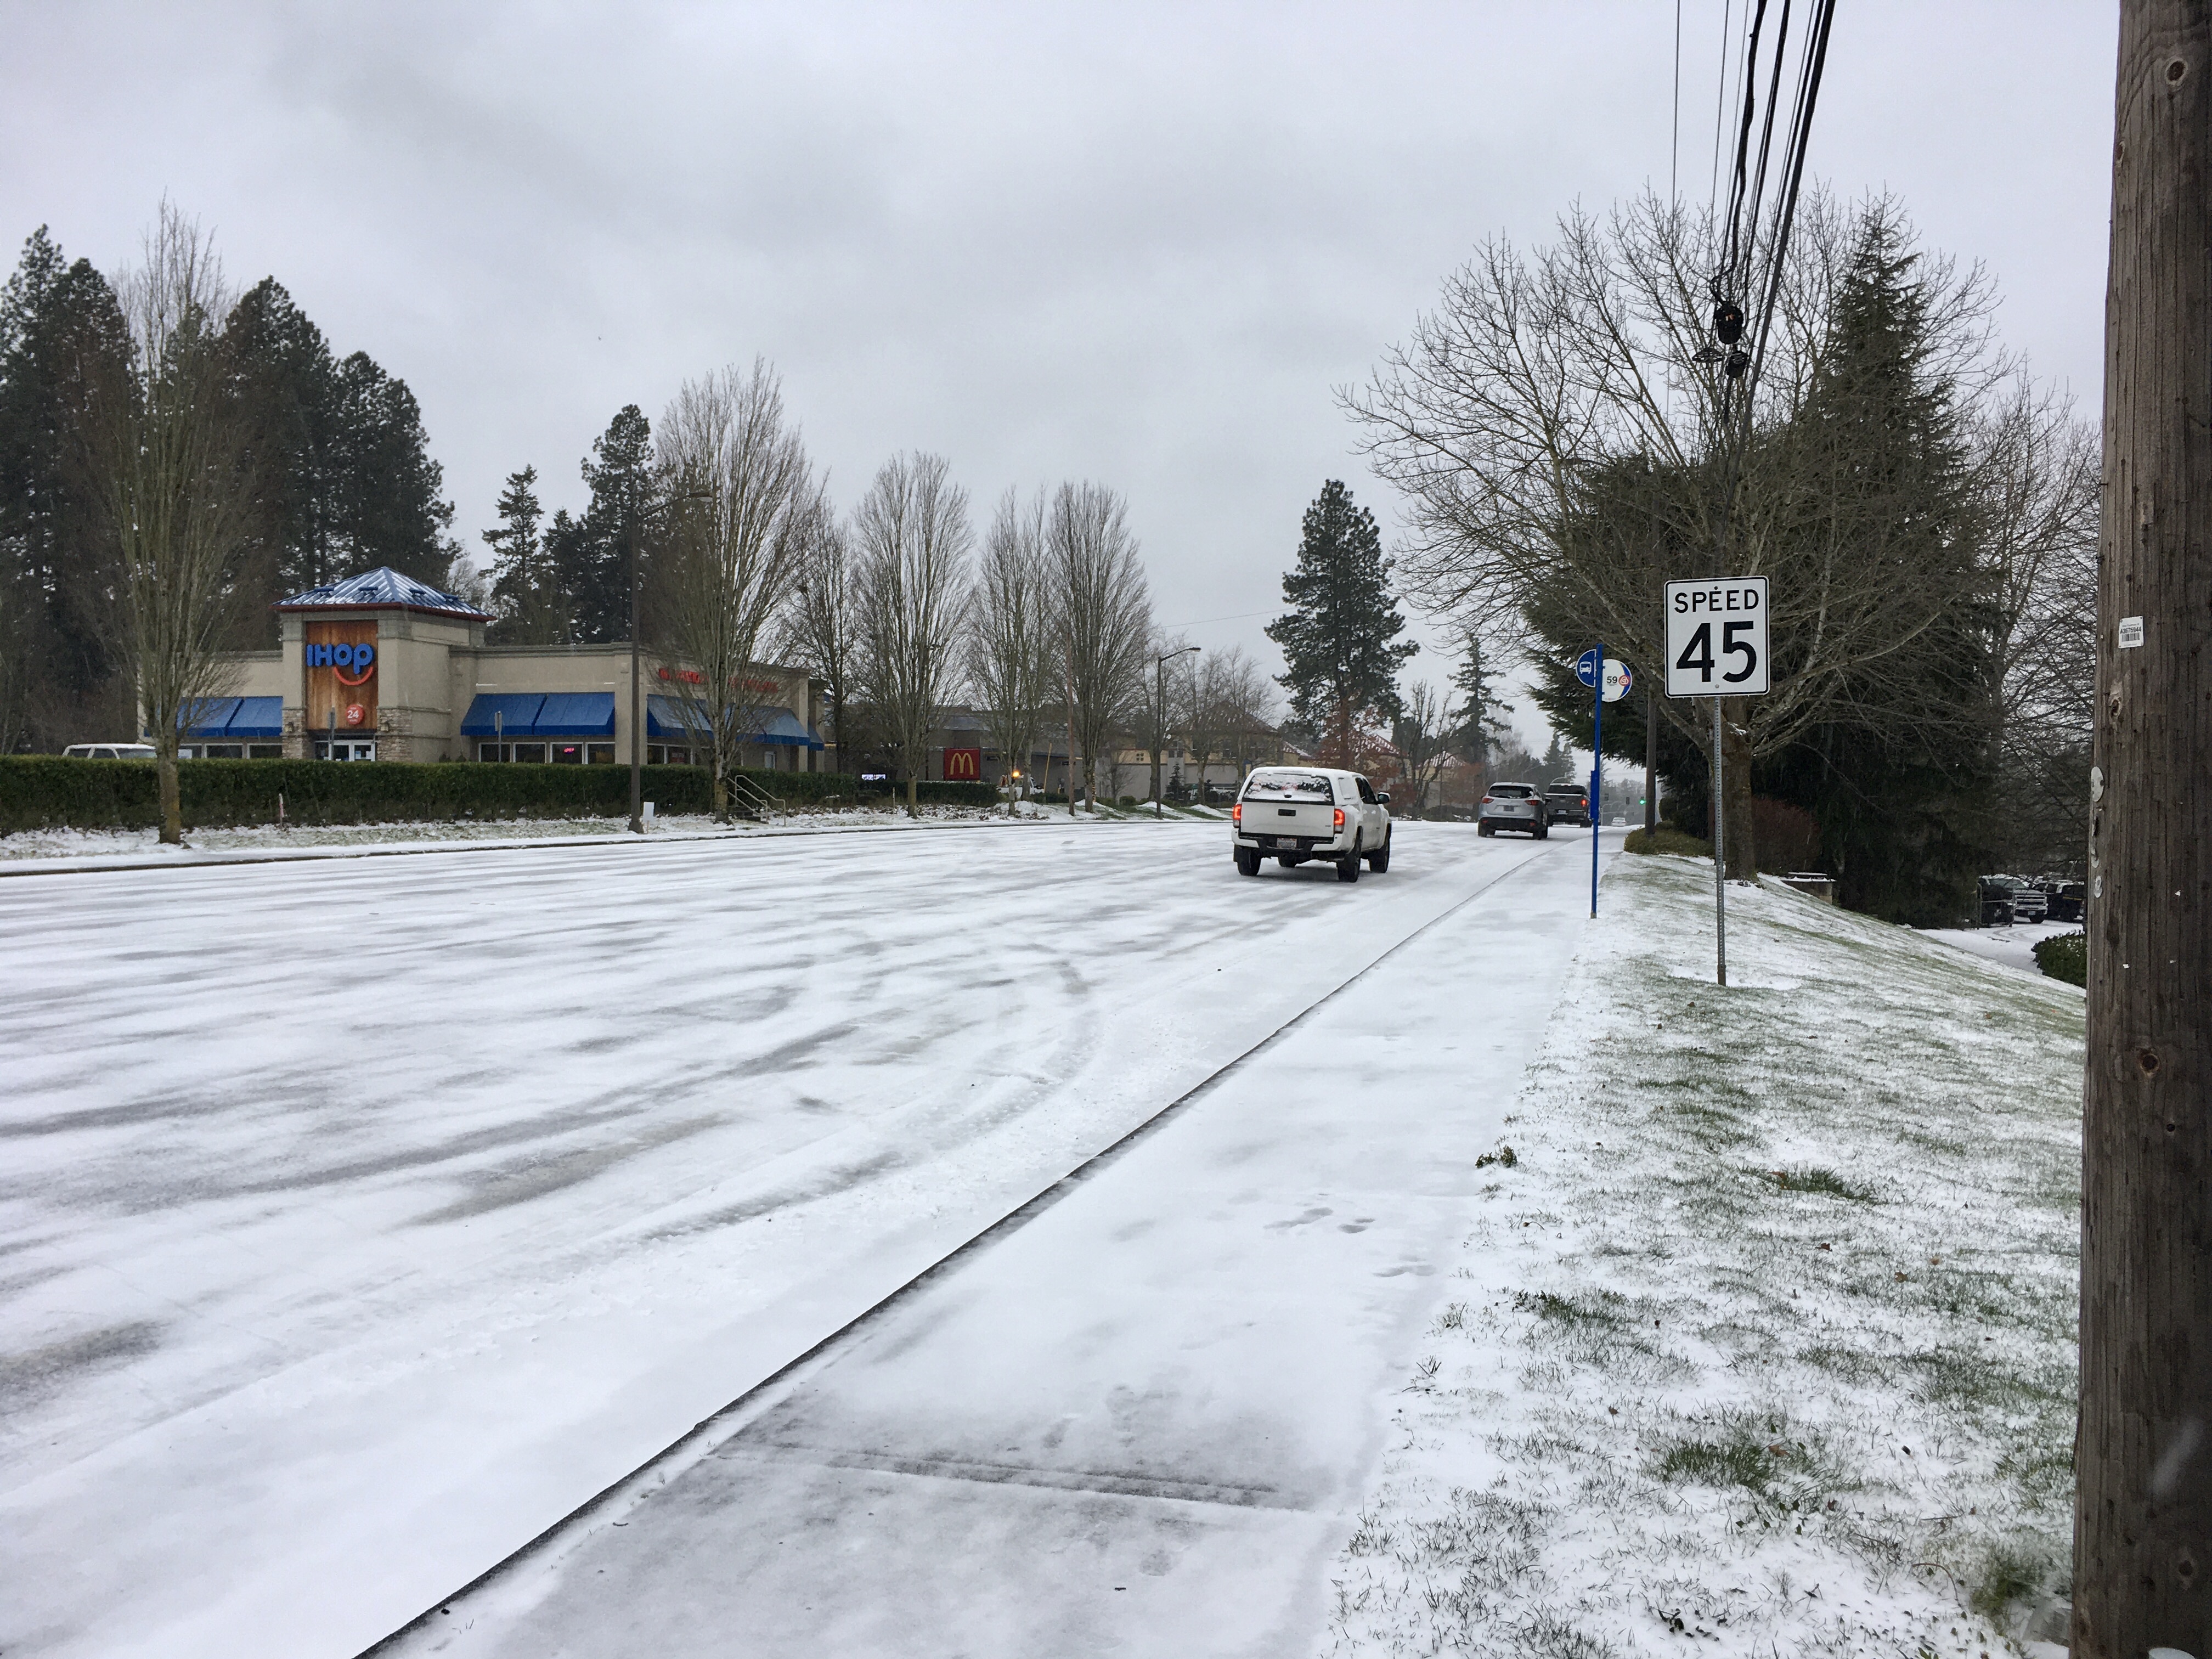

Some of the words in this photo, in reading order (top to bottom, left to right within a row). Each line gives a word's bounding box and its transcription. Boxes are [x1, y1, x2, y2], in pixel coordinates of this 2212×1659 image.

[1674, 589, 1759, 613] SPEED
[1676, 620, 1757, 682] 45
[347, 709, 359, 719] 24
